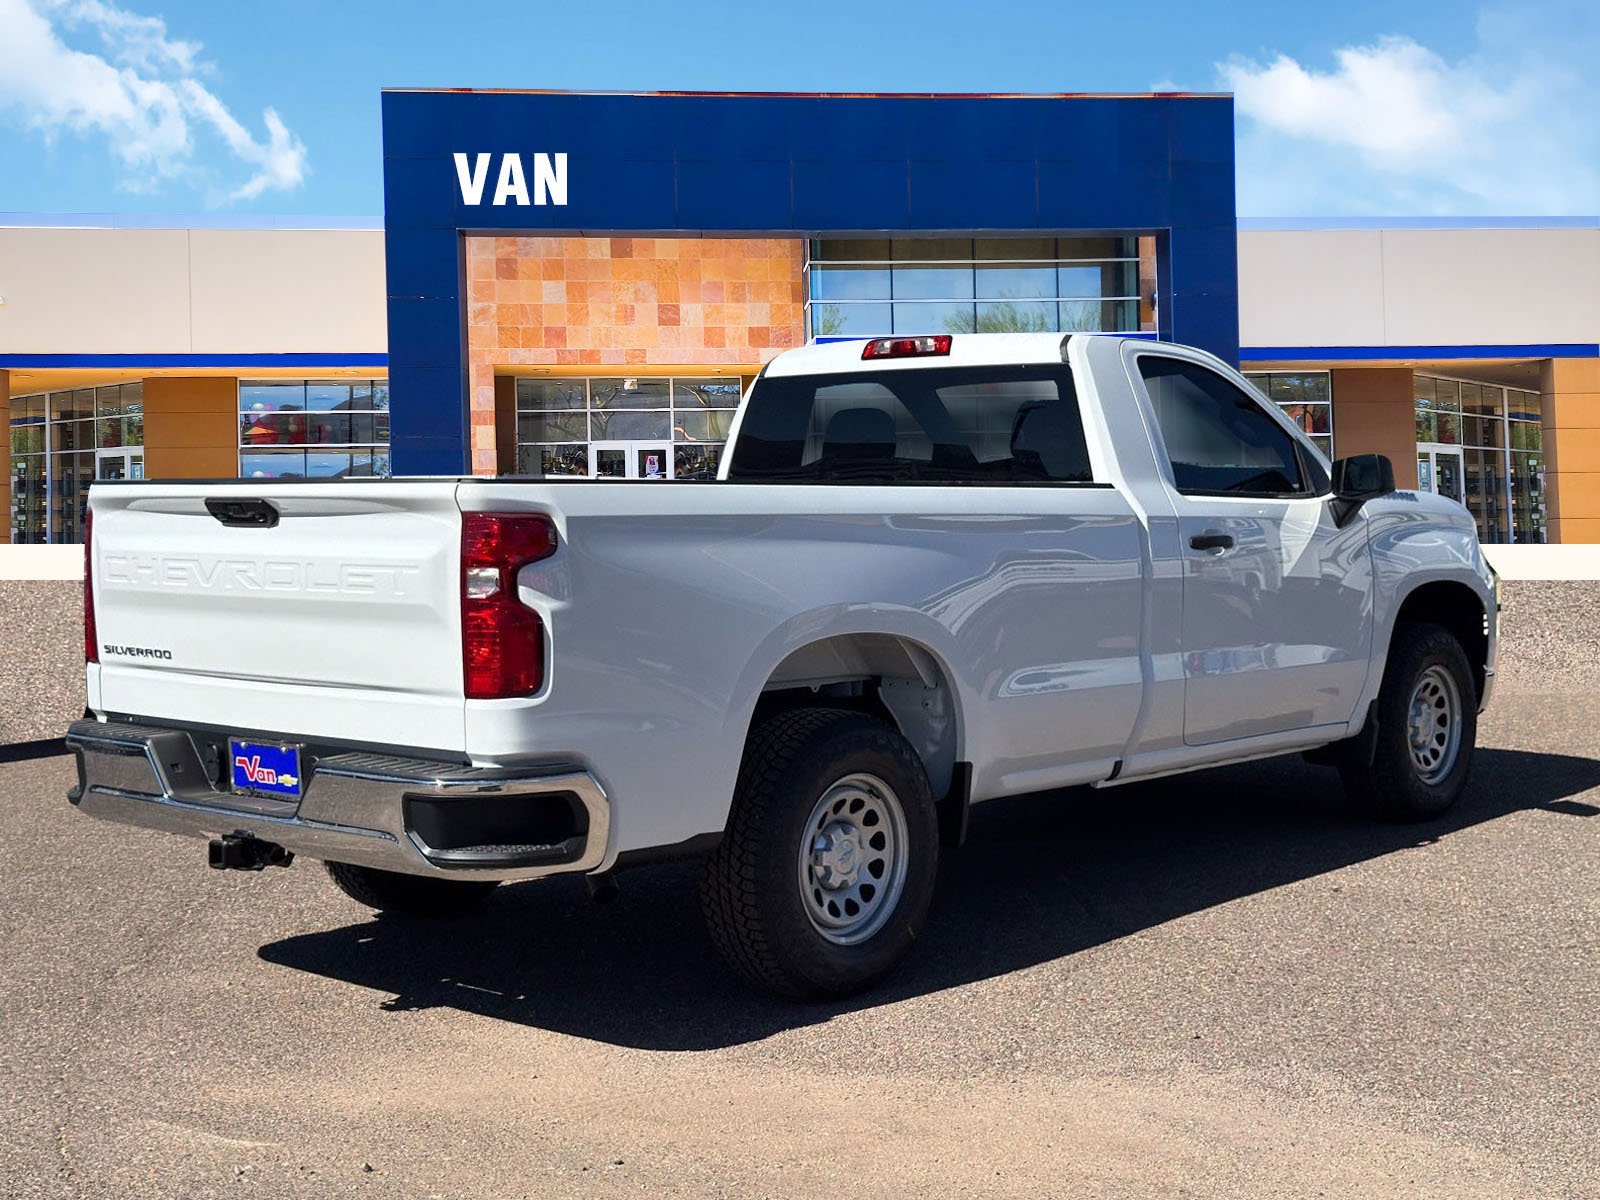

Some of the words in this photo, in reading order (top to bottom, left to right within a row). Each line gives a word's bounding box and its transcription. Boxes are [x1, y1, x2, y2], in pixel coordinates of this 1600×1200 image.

[453, 152, 568, 206] VAN
[103, 555, 420, 596] CHEVROLET
[103, 644, 173, 660] SILVERADO
[236, 755, 277, 785] Van
